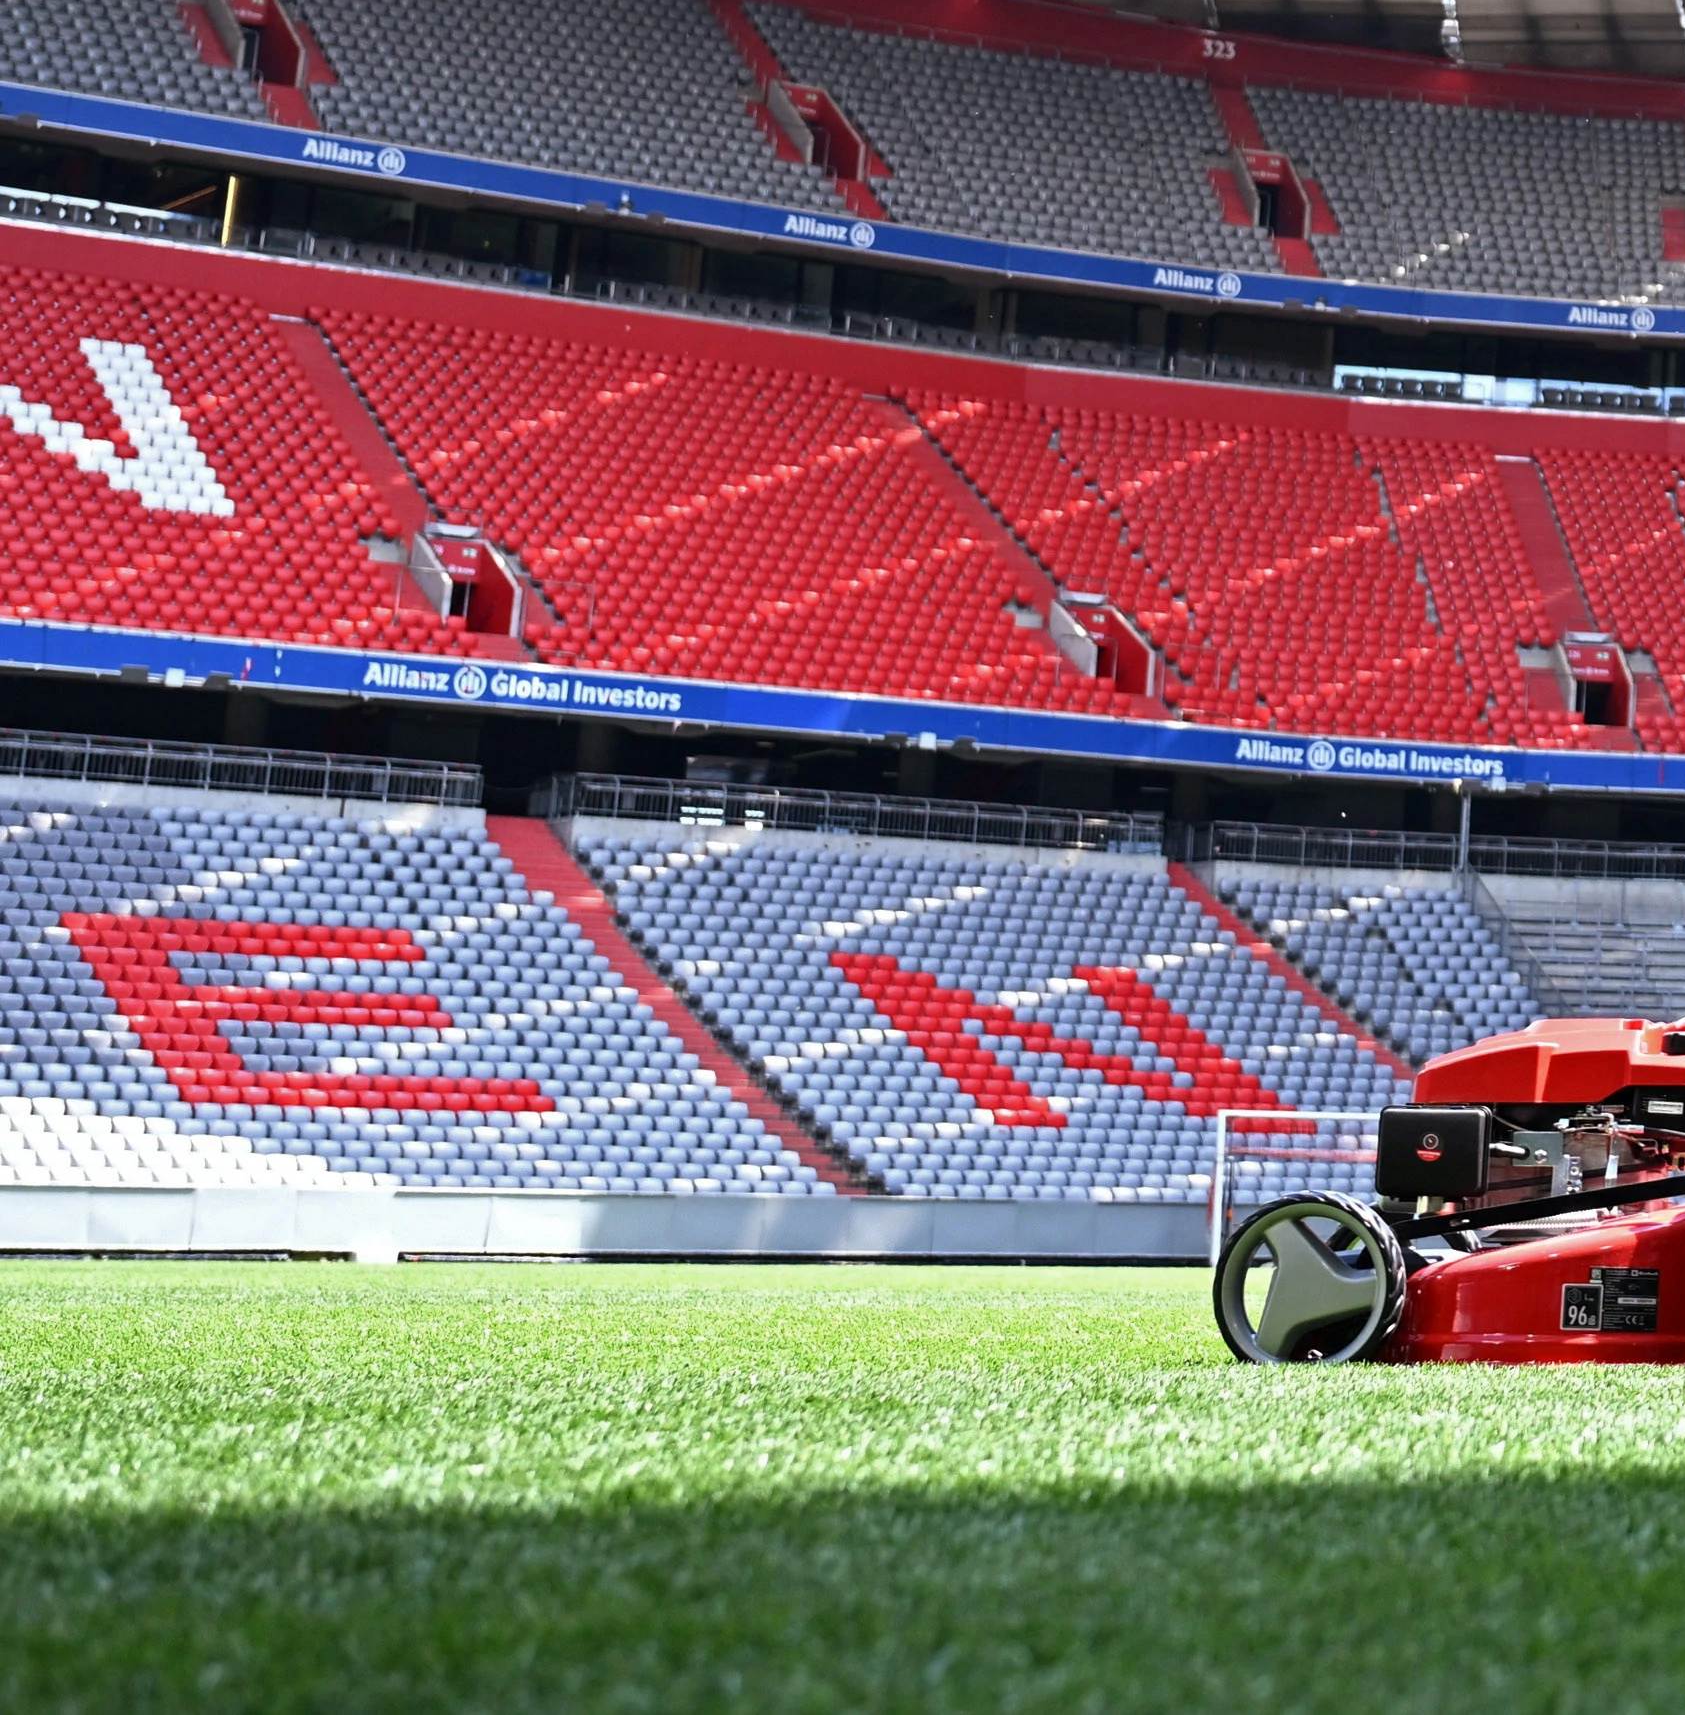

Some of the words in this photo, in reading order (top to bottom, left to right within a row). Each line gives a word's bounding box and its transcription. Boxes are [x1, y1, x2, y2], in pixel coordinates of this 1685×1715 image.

[1203, 38, 1236, 60] 323
[302, 138, 374, 169] Allianz
[784, 215, 848, 242] Allianz
[1154, 268, 1214, 292] Allianz
[1568, 306, 1628, 327] Allianz
[363, 662, 449, 694] Allianz
[491, 672, 568, 702] Global
[574, 682, 682, 712] Investors
[1235, 738, 1304, 764] Allianz
[1339, 746, 1406, 771] Global
[1410, 751, 1504, 777] Investors
[1568, 1305, 1588, 1325] 96
